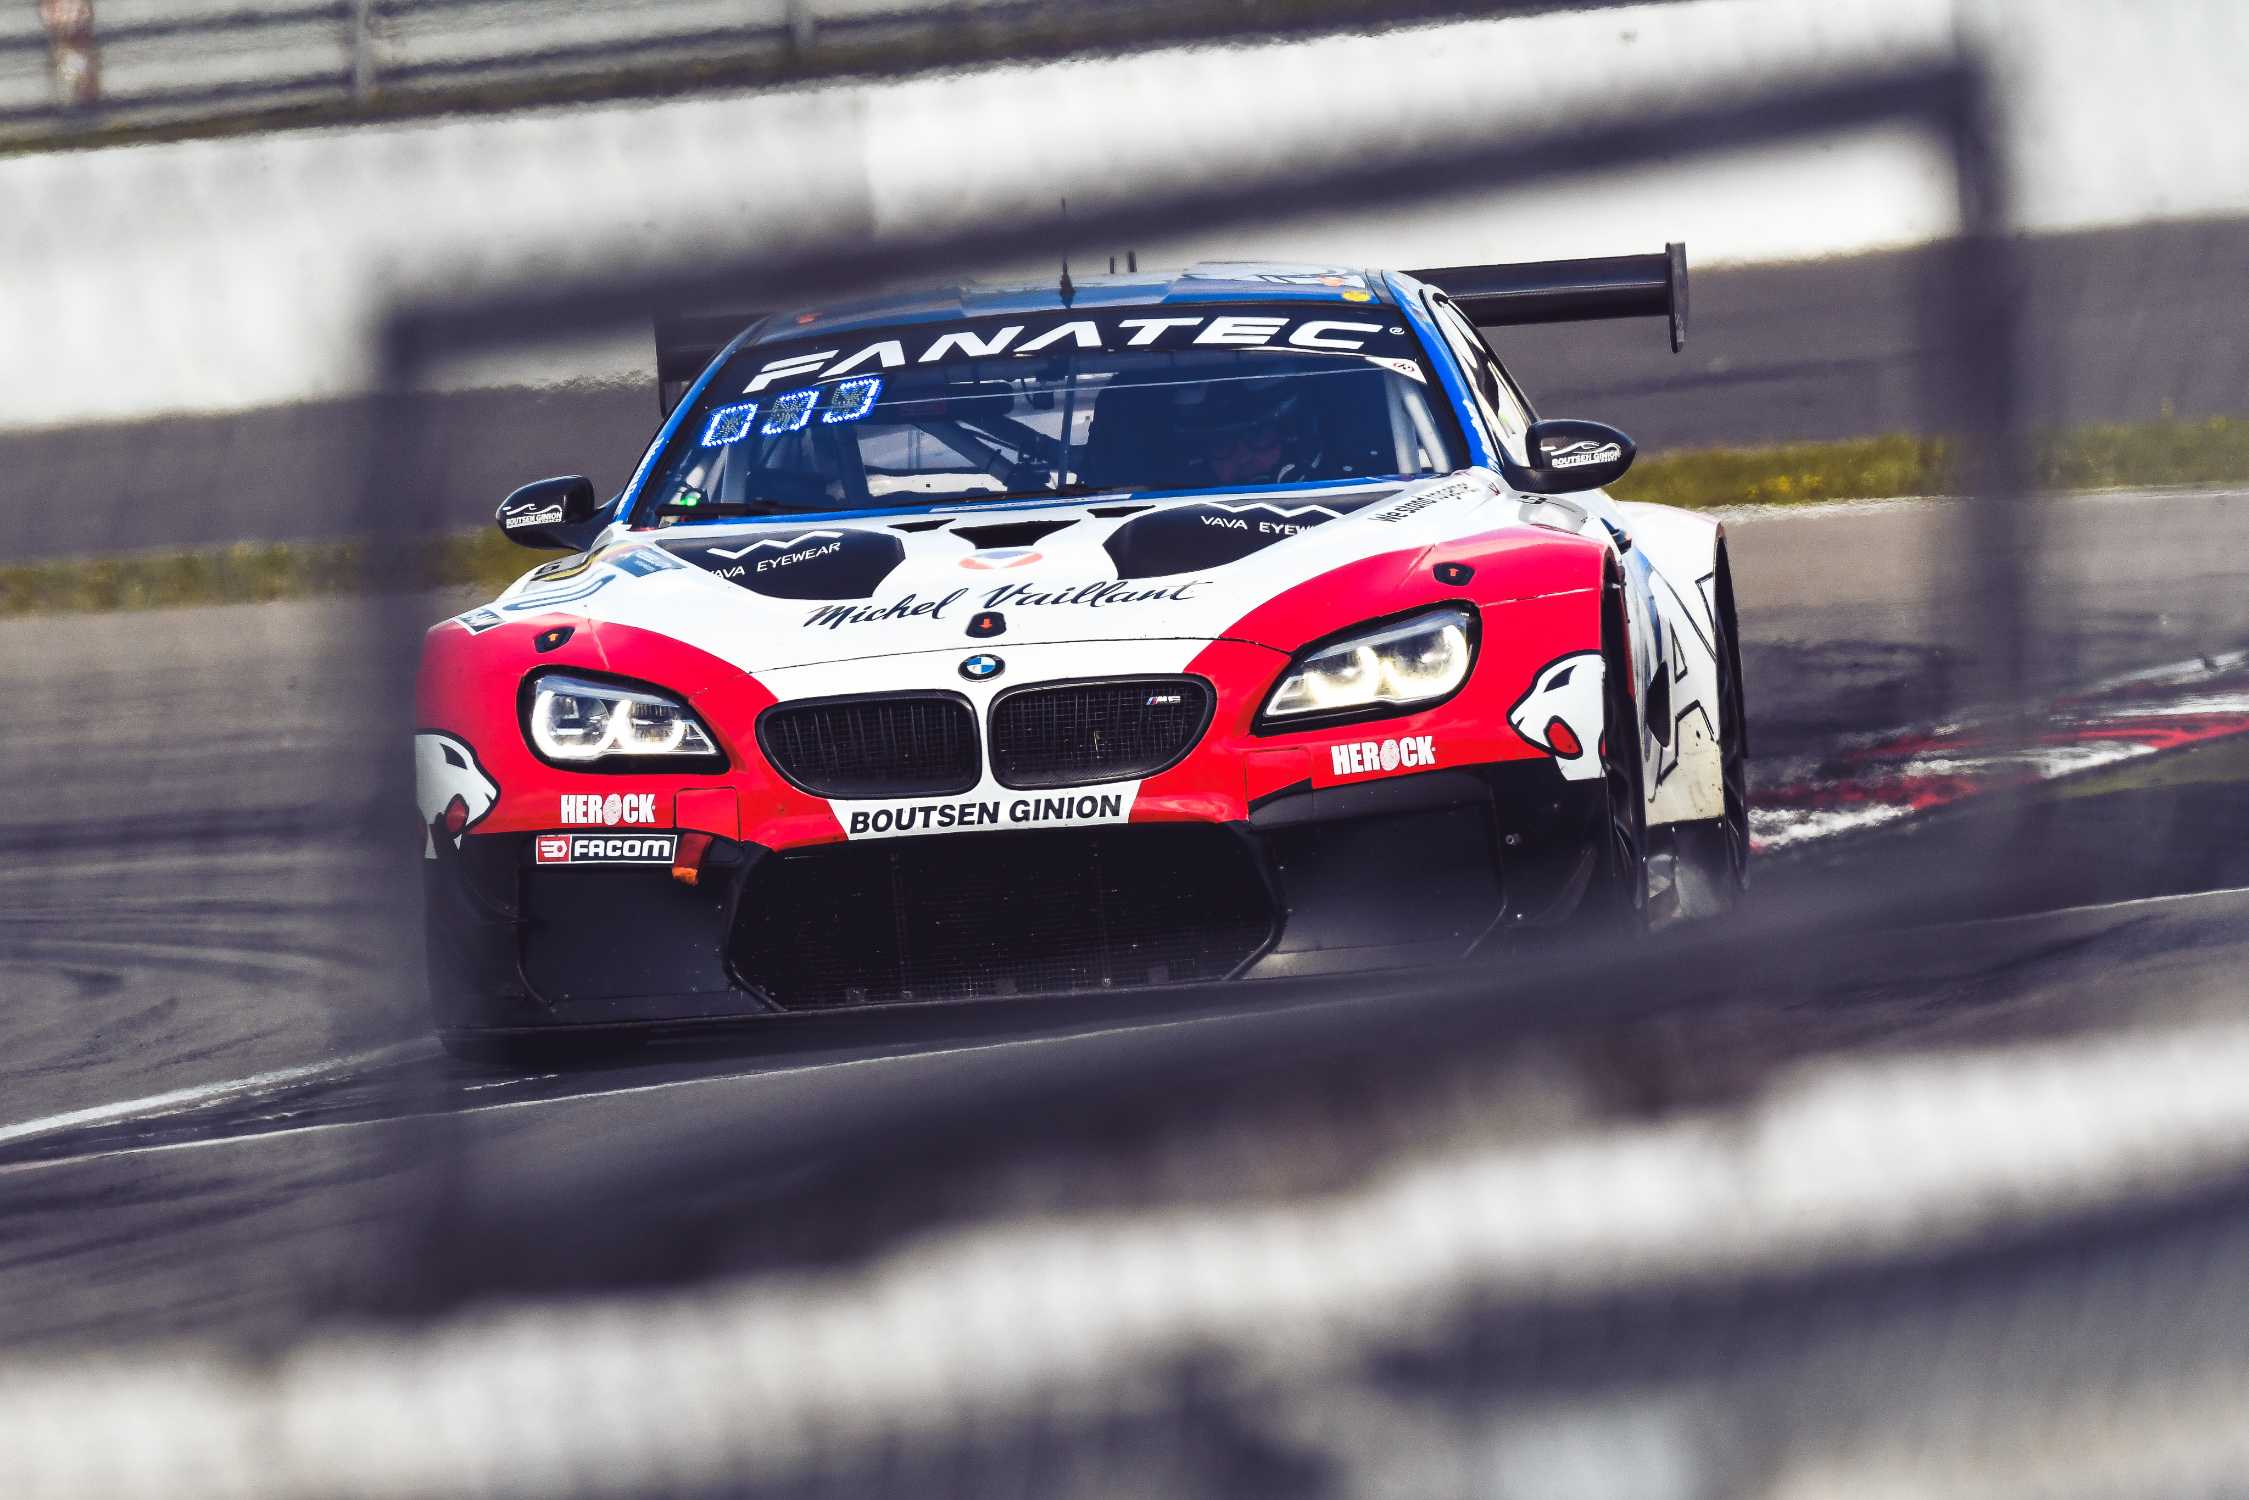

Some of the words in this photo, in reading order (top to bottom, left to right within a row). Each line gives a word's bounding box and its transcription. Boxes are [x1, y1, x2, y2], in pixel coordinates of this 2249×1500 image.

[742, 316, 1384, 394] FANATEC
[1200, 515, 1248, 530] VAVA
[710, 566, 745, 579] AVA
[756, 542, 841, 572] EYEWEAR
[803, 588, 968, 630] Michel
[978, 581, 1213, 609] Vaillant
[1331, 736, 1436, 776] HEROCK
[560, 793, 656, 825] HEROCK
[850, 801, 1000, 834] BOUTSEN
[1009, 794, 1122, 823] GINION
[574, 838, 670, 857] FACOM
